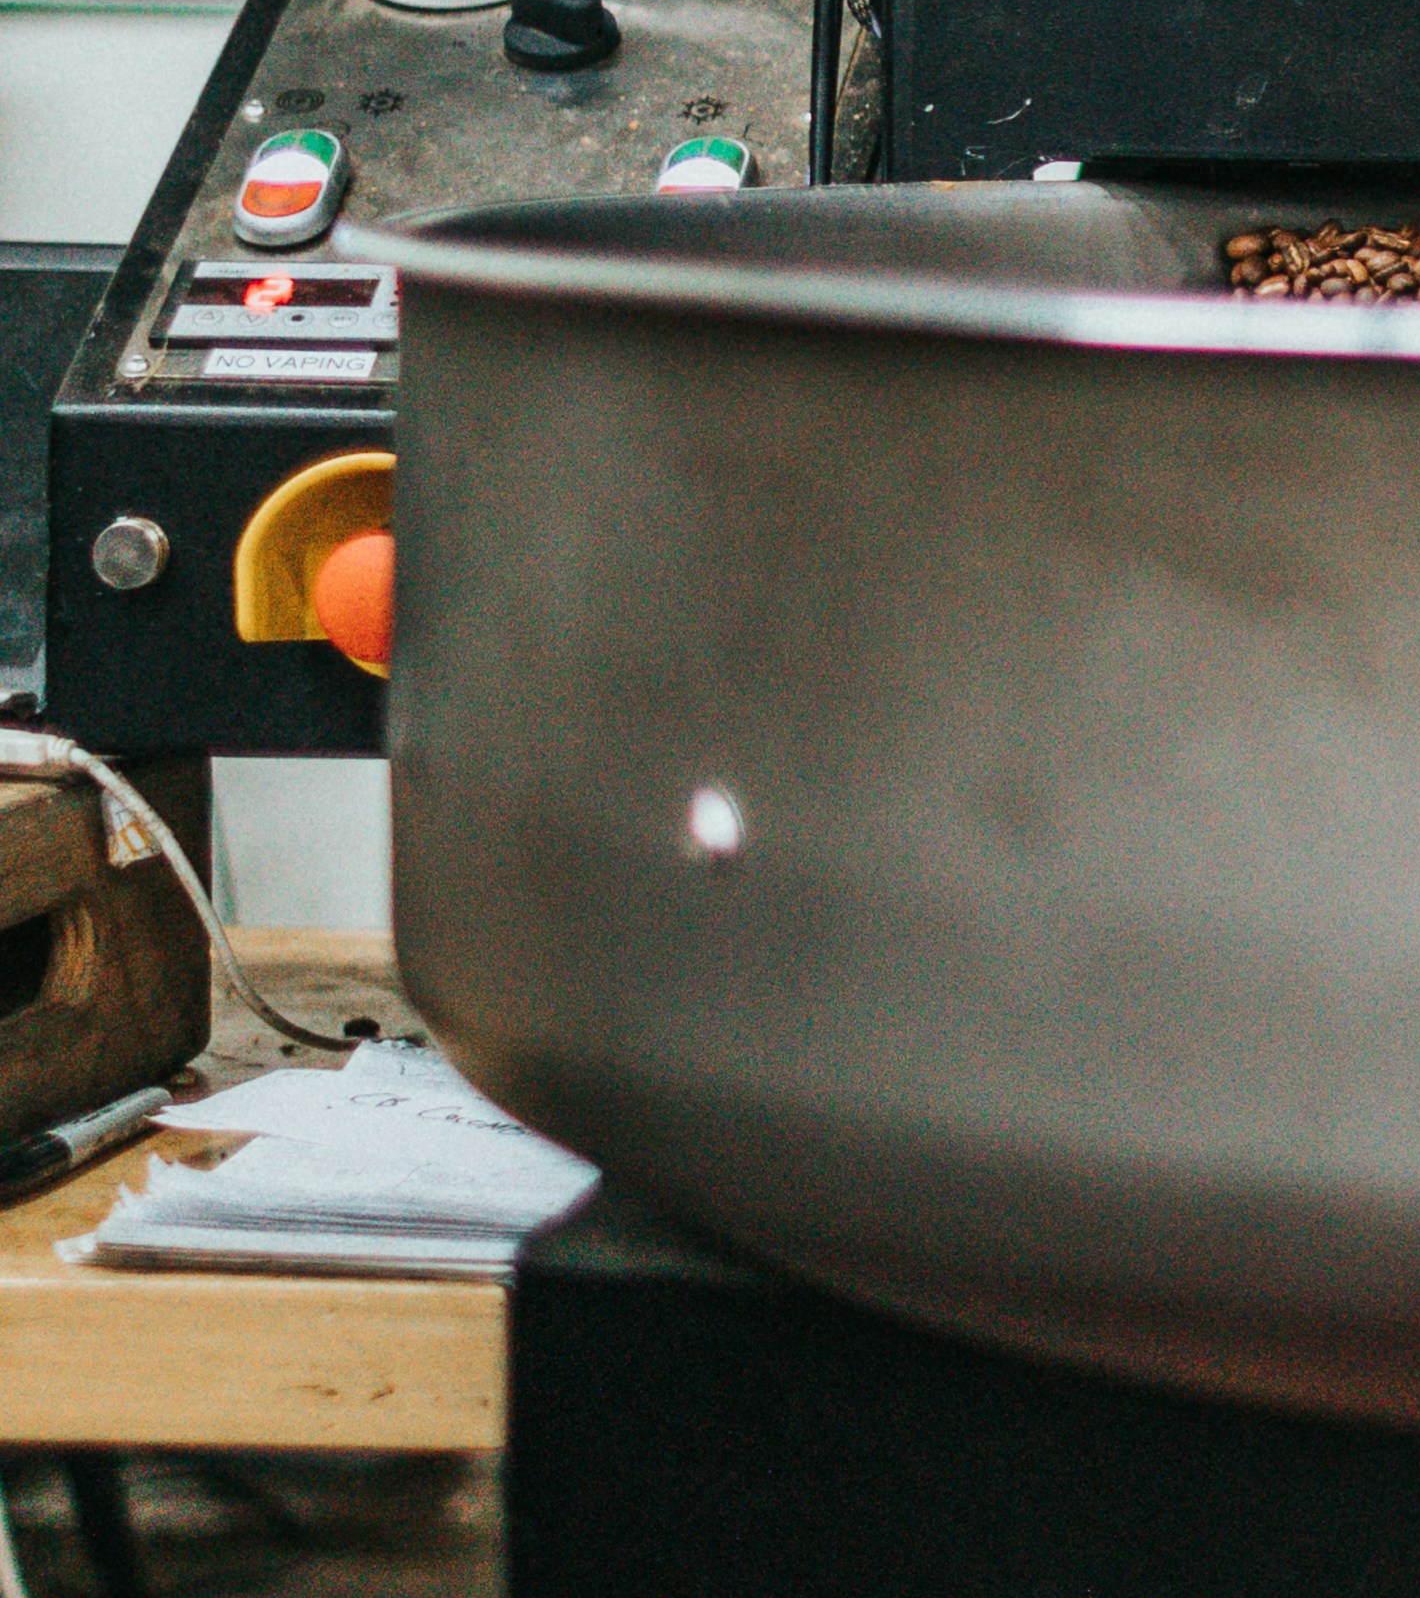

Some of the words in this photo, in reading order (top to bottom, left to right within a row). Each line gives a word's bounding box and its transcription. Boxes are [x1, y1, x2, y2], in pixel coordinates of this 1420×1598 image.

[245, 277, 295, 310] 2
[215, 355, 256, 369] NO
[265, 356, 367, 371] VAPING
